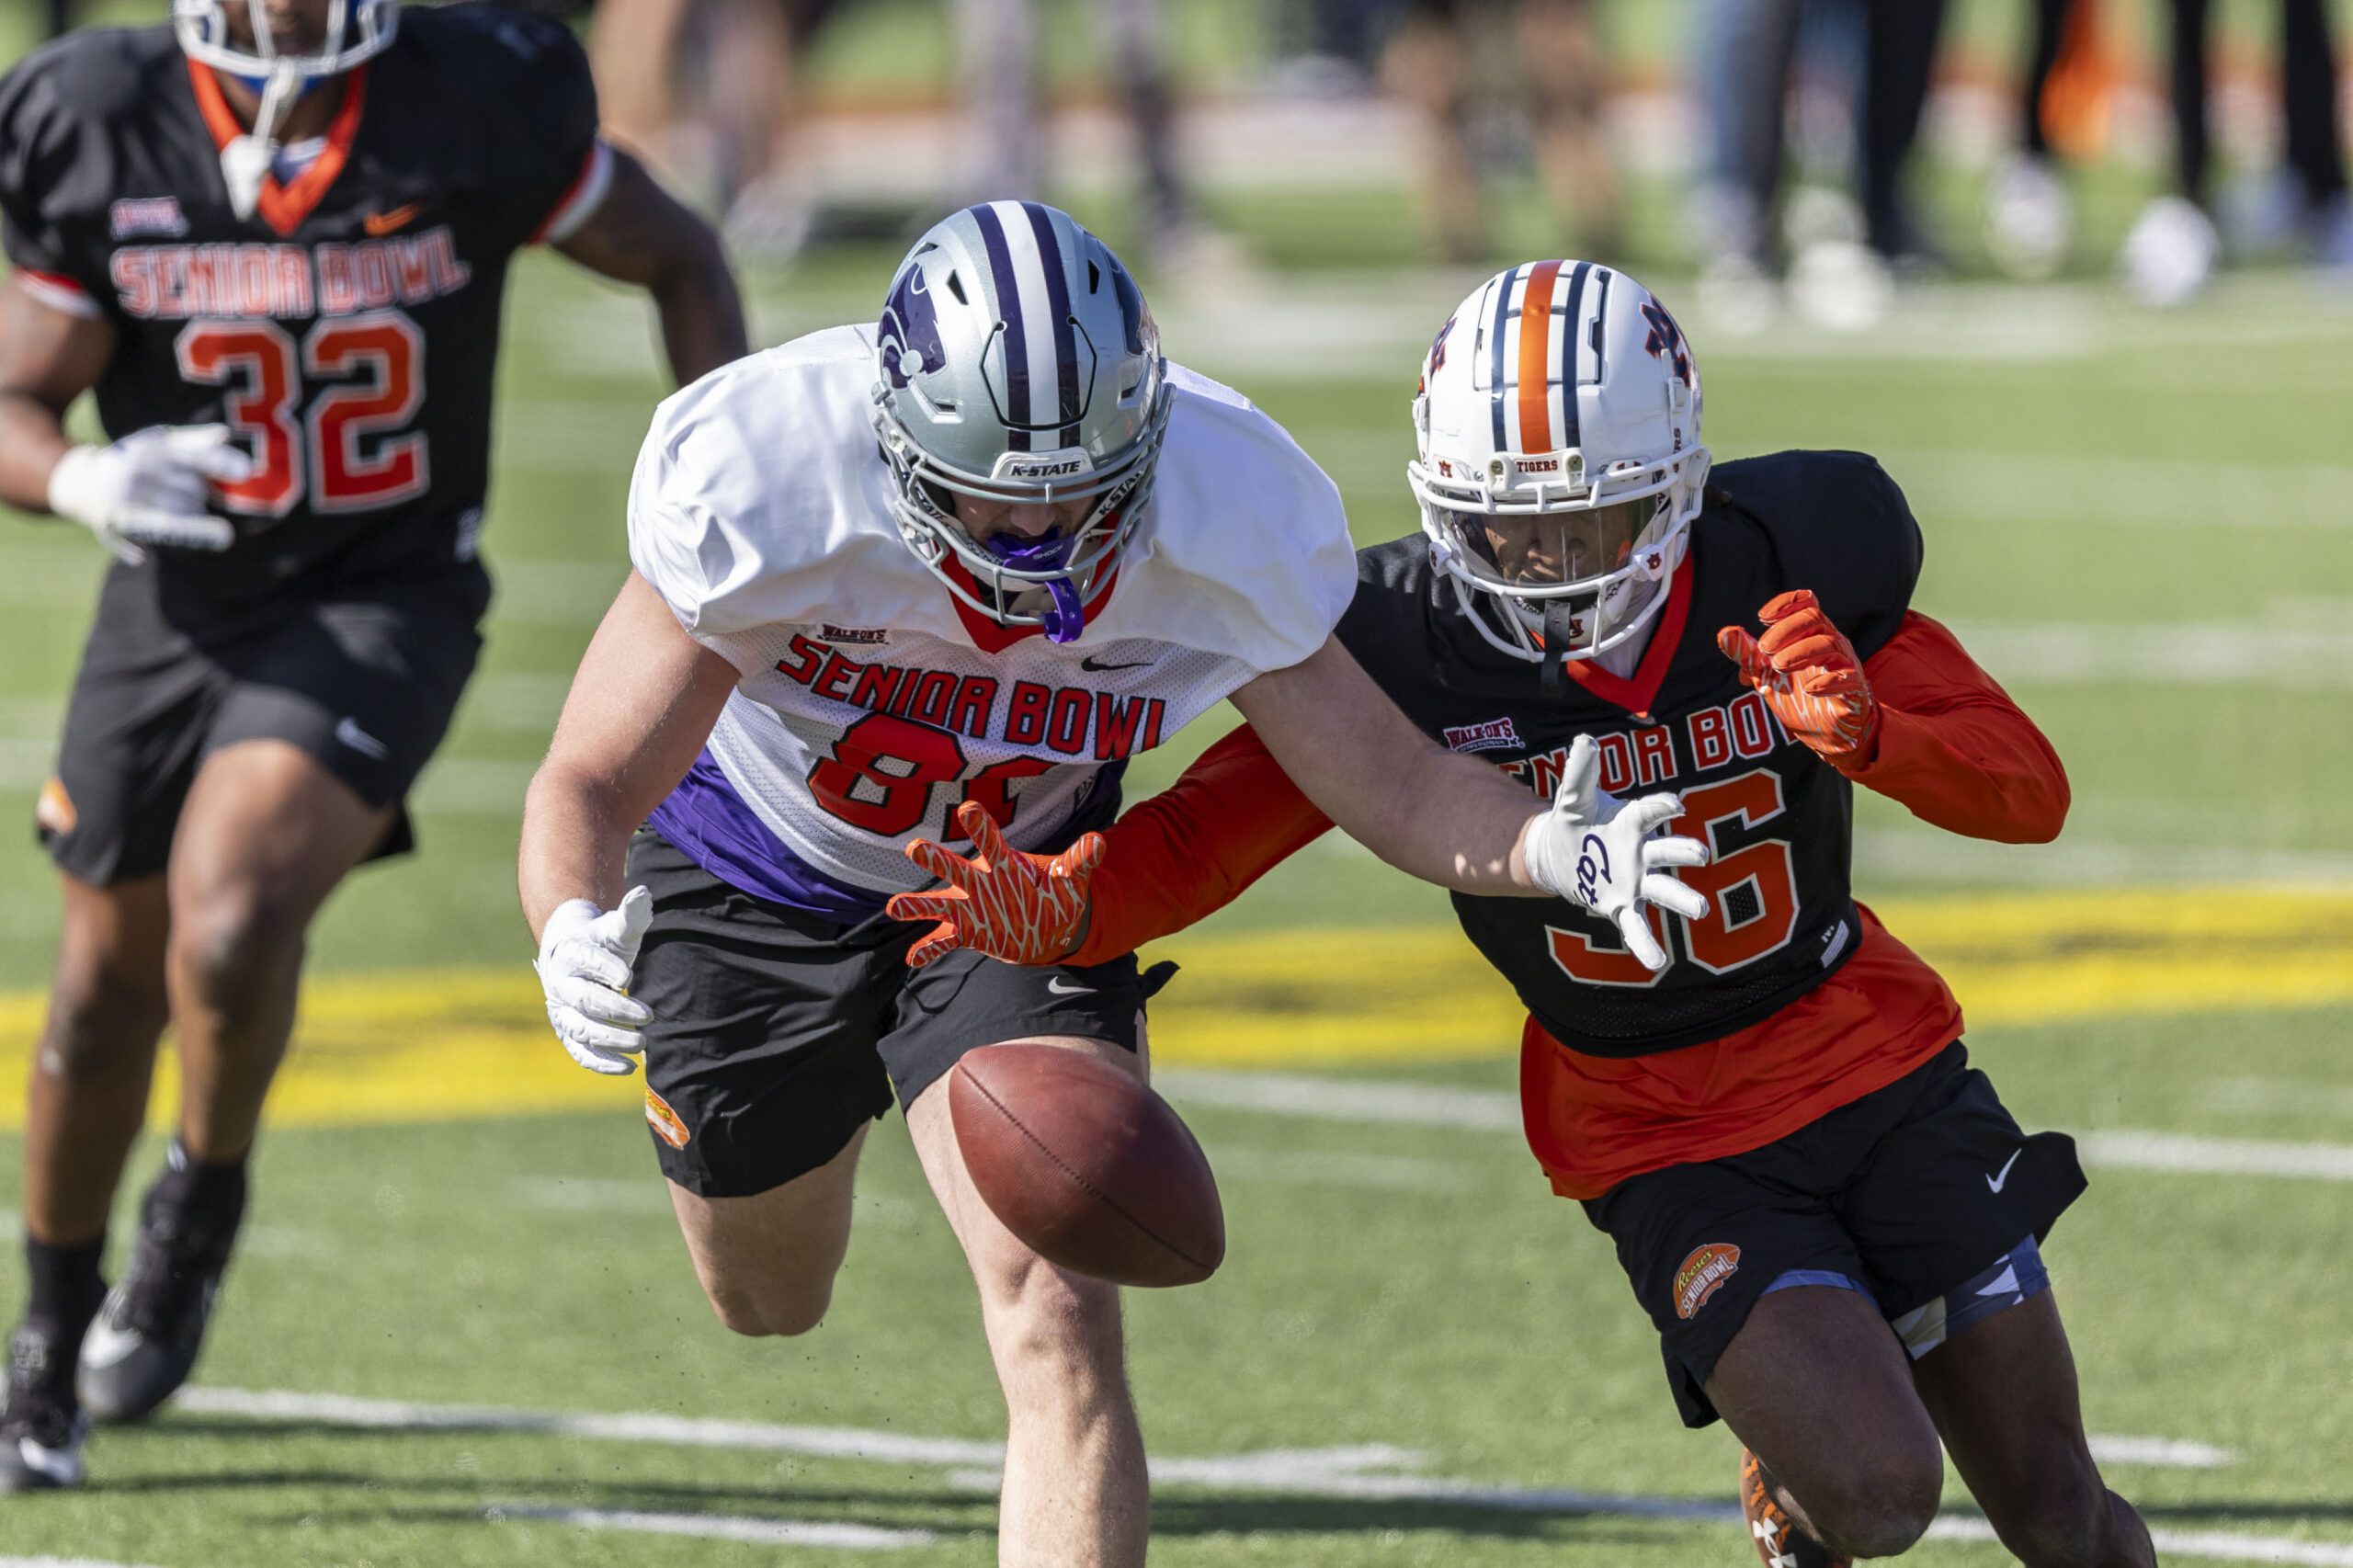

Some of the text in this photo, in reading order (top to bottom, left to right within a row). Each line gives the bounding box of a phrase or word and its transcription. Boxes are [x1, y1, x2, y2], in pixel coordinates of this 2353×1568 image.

[110, 229, 471, 319] SENIOR BOWL
[175, 307, 431, 517] 32
[1011, 460, 1081, 477] K-STATE
[1098, 470, 1142, 516] K-STA
[1517, 460, 1559, 472] TIGERS
[775, 633, 998, 738] SENIOR
[1682, 1256, 1735, 1315] SENIOR BOWL
